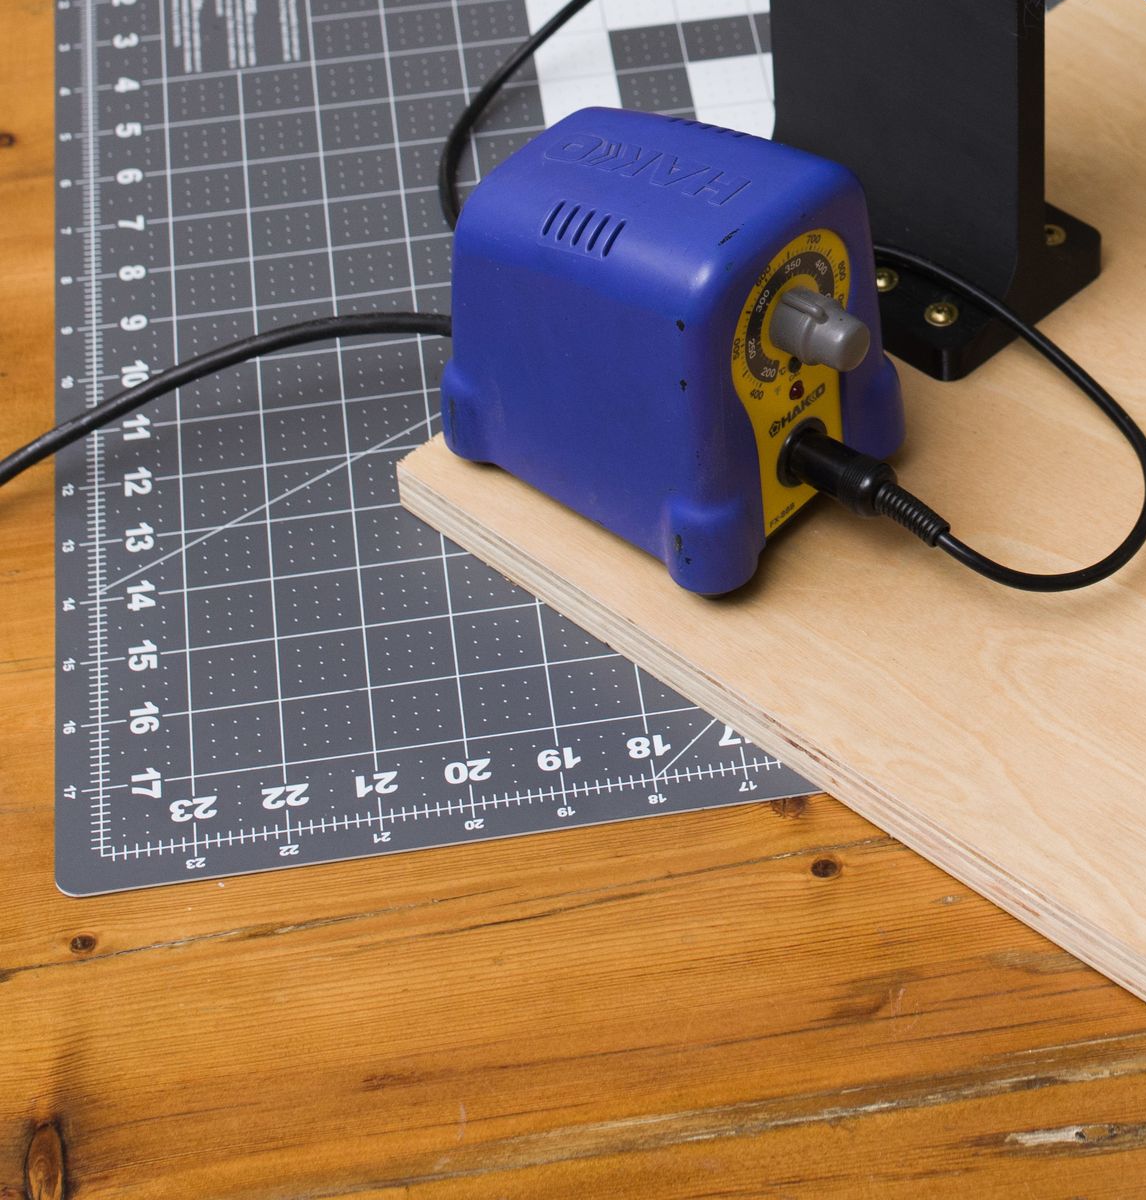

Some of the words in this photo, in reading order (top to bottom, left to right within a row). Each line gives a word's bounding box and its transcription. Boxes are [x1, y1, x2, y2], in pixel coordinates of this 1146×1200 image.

[113, 33, 139, 49] 3
[114, 77, 140, 93] 4
[115, 122, 142, 138] 5
[116, 168, 143, 185] 6
[118, 214, 144, 231] 7
[118, 264, 146, 282] 8
[784, 258, 801, 274] 350
[815, 259, 827, 275] 400
[756, 289, 770, 313] 300
[120, 314, 148, 331] 9
[748, 338, 756, 359] 250
[121, 360, 149, 387] 10
[760, 366, 776, 378] 200
[122, 413, 150, 441] 11
[62, 482, 74, 497] 12
[123, 466, 152, 497] 12
[125, 522, 154, 552] 13
[62, 539, 75, 553] 13
[126, 579, 156, 611] 14
[62, 596, 75, 612] 14
[128, 639, 158, 671] 15
[63, 657, 76, 672] 15
[129, 701, 160, 735] 16
[63, 720, 76, 735] 16
[718, 724, 754, 747] 7
[626, 734, 672, 759] 18
[537, 747, 582, 771] 19
[444, 758, 492, 784] 20
[131, 767, 162, 799] 17
[355, 770, 399, 798] 21
[739, 780, 758, 792] 17
[64, 784, 77, 800] 17
[261, 783, 310, 810] 22
[648, 793, 667, 805] 18
[169, 795, 218, 823] 23
[557, 805, 576, 817] 19
[464, 818, 485, 830] 20
[372, 831, 391, 844] 21
[279, 844, 299, 856] 22
[186, 857, 206, 869] 23
